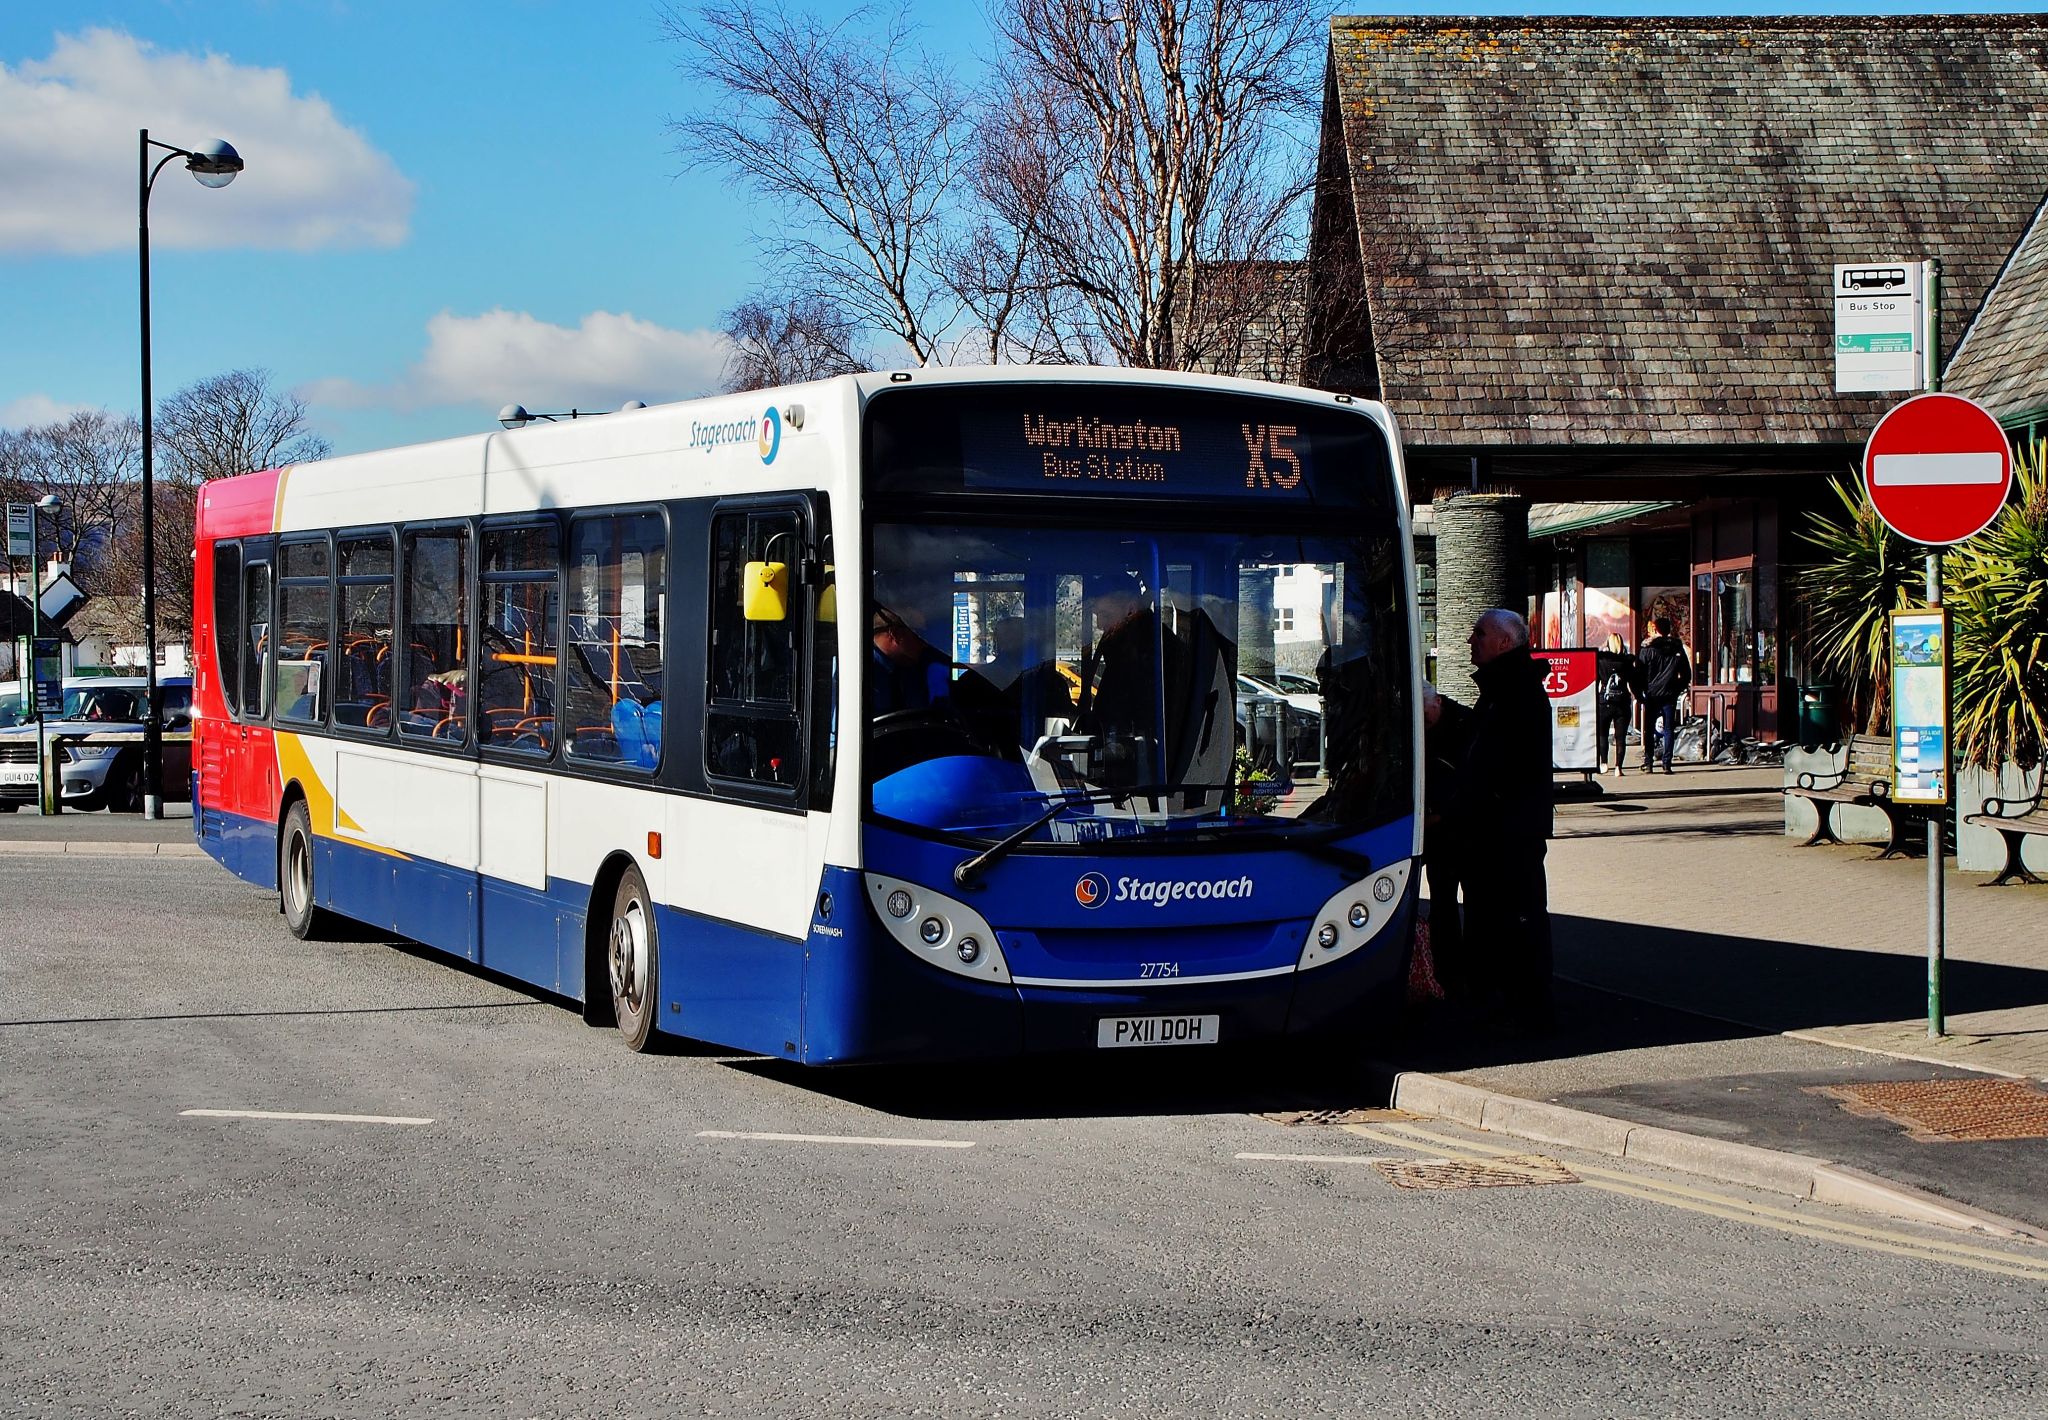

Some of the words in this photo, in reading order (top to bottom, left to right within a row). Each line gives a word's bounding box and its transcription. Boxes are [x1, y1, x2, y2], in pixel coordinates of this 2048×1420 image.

[1849, 302, 1868, 311] Bus
[1872, 301, 1896, 311] Stop
[690, 415, 756, 453] Stagecoach
[1023, 413, 1181, 452] Workington
[1043, 452, 1081, 478] Bus
[1086, 454, 1165, 481] Station
[1241, 423, 1301, 489] X5
[1542, 671, 1569, 693] £5
[1114, 875, 1253, 908] Stagecoach
[812, 923, 843, 938] SCREENWASH
[1140, 962, 1180, 978] 27754
[1115, 1020, 1155, 1043] PX11
[1160, 1018, 1203, 1041] DOH
